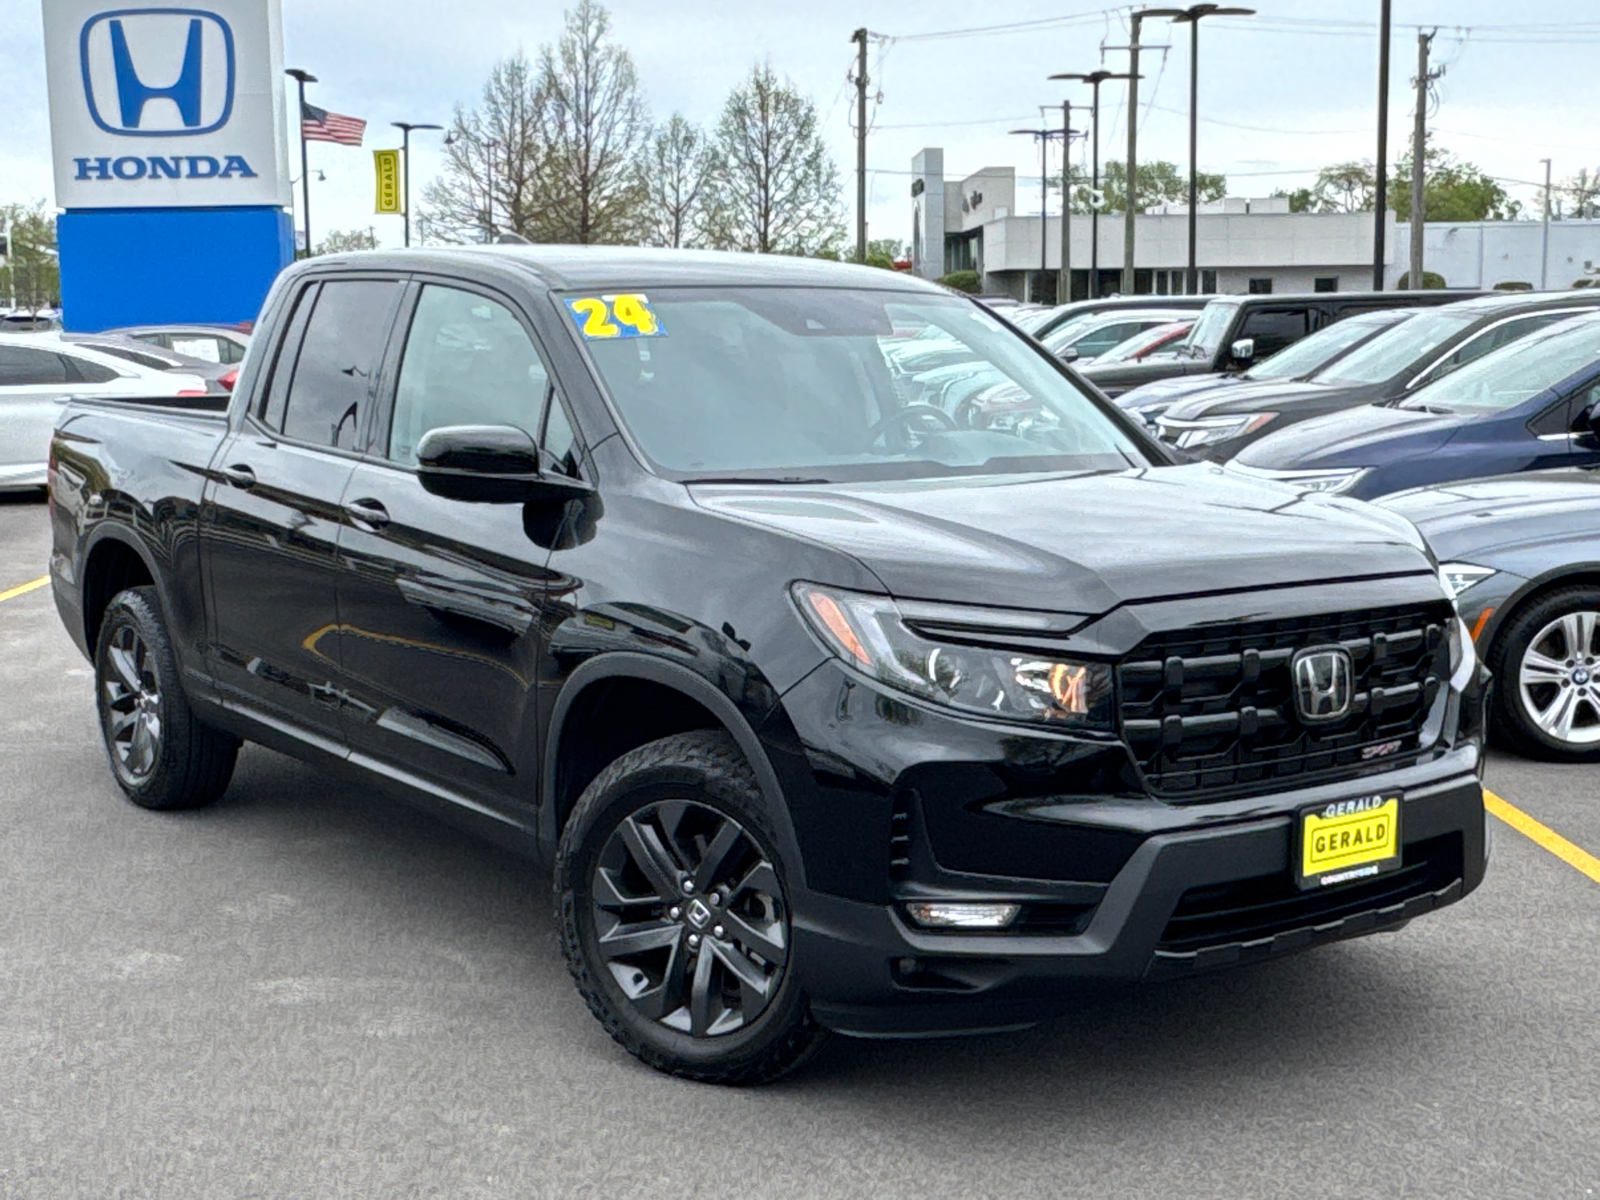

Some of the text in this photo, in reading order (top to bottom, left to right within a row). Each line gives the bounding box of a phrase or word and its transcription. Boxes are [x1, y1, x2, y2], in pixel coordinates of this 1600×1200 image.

[73, 155, 259, 181] HONDA
[383, 157, 393, 207] GERALD
[570, 295, 660, 337] 24
[1325, 795, 1383, 818] GERALD
[1315, 823, 1386, 854] GERALD
